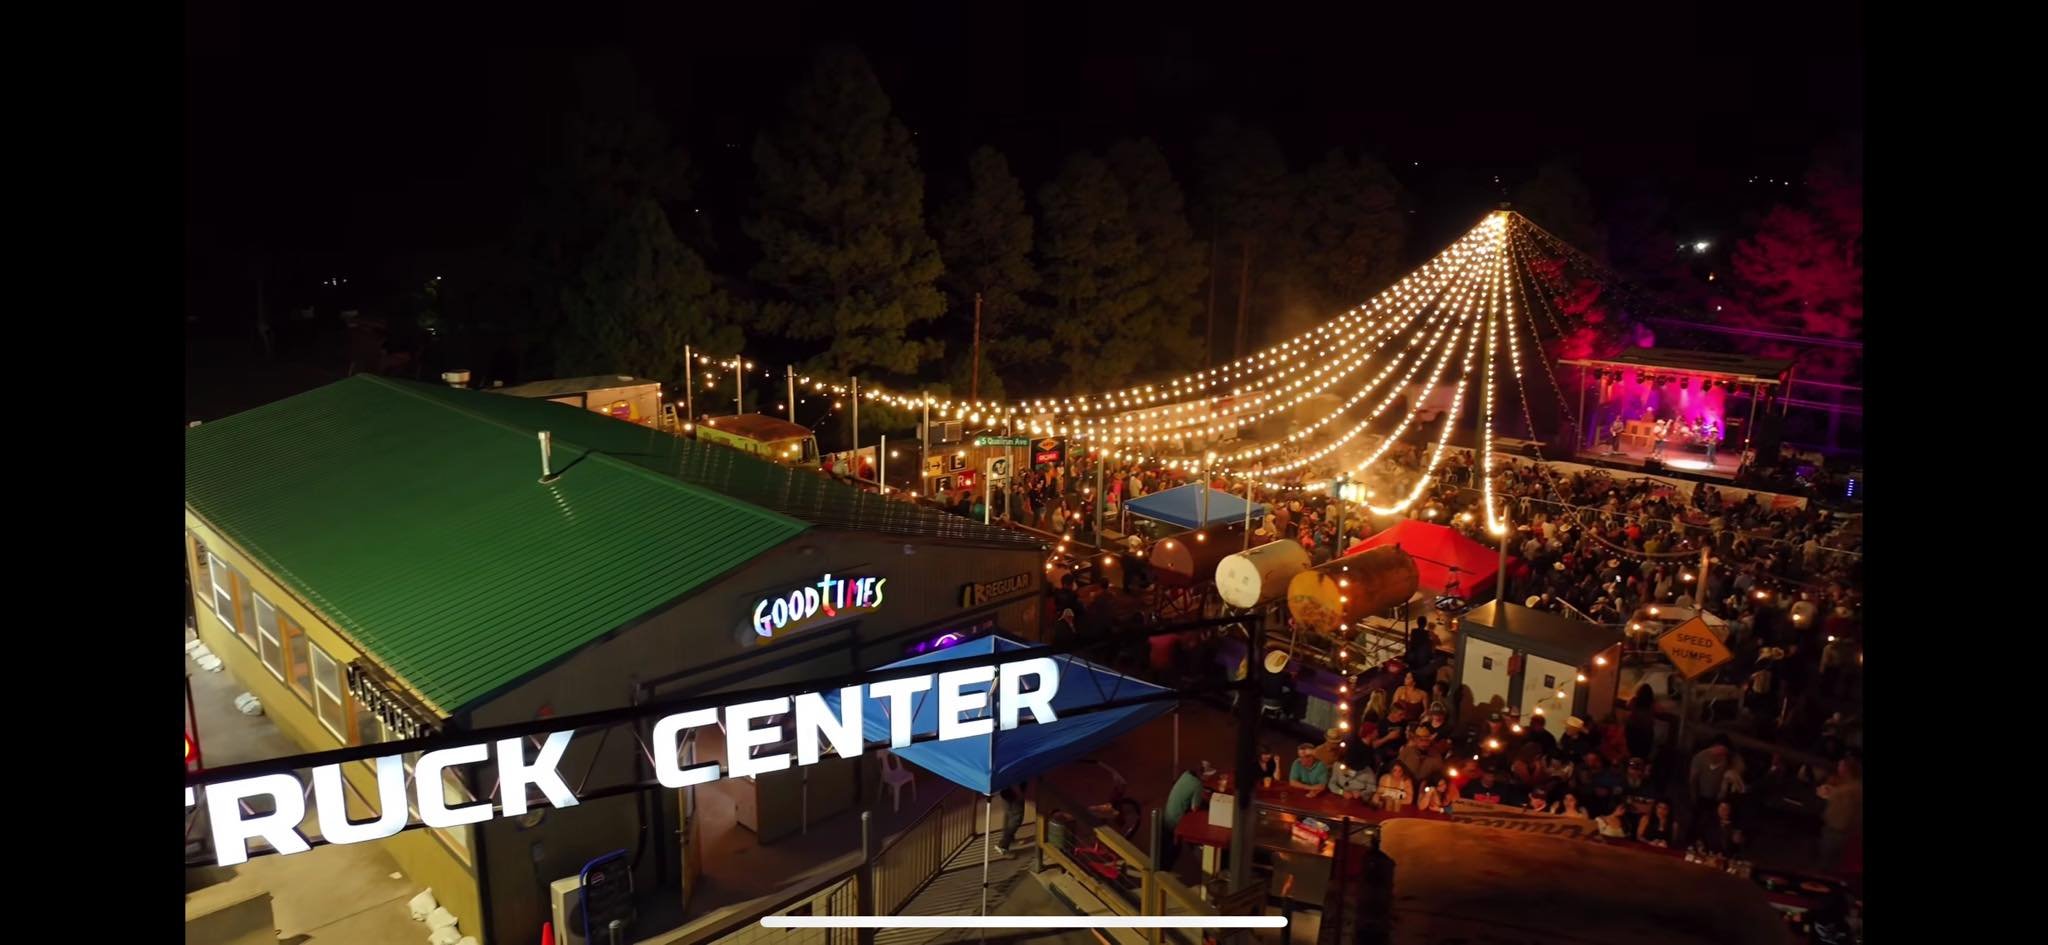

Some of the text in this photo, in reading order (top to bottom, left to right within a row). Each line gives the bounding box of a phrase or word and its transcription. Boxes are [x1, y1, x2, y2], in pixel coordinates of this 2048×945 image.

[1677, 633, 1713, 648] SPEED
[1672, 647, 1713, 663] HUMPS
[185, 656, 1061, 867] RUCK CENTER
